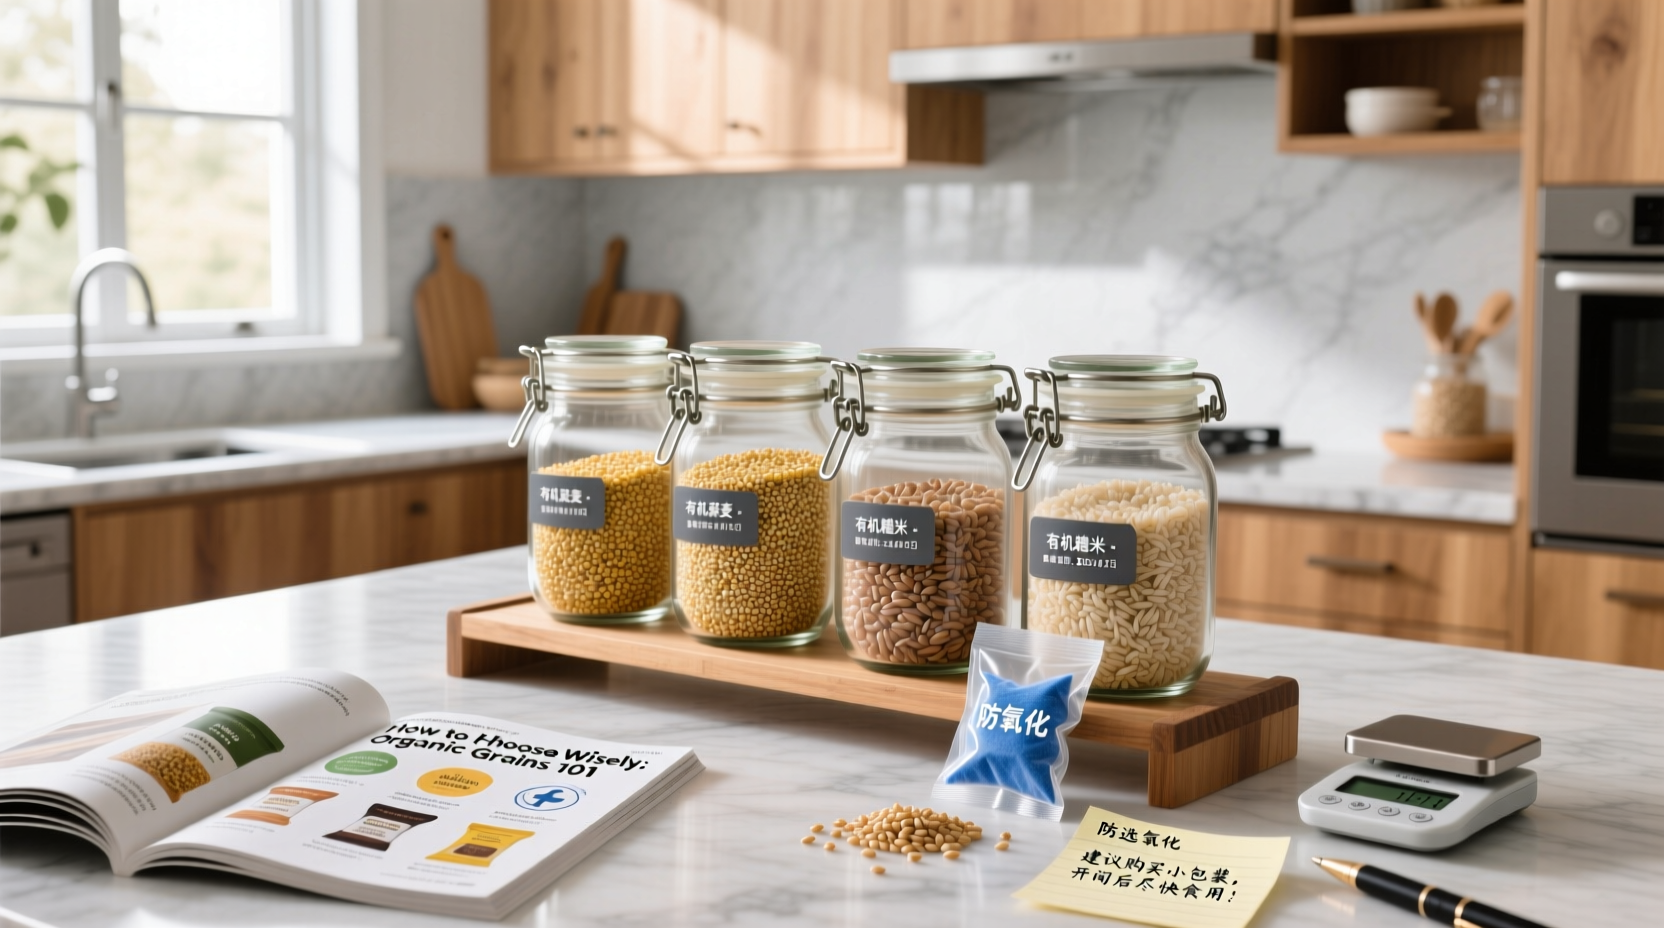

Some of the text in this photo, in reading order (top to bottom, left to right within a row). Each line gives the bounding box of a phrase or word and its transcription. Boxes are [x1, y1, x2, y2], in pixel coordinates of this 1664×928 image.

[976, 702, 1051, 738] 防氧化
[370, 734, 598, 778] Organic Grains 101
[445, 728, 469, 740] to
[565, 748, 649, 771] Wisely:
